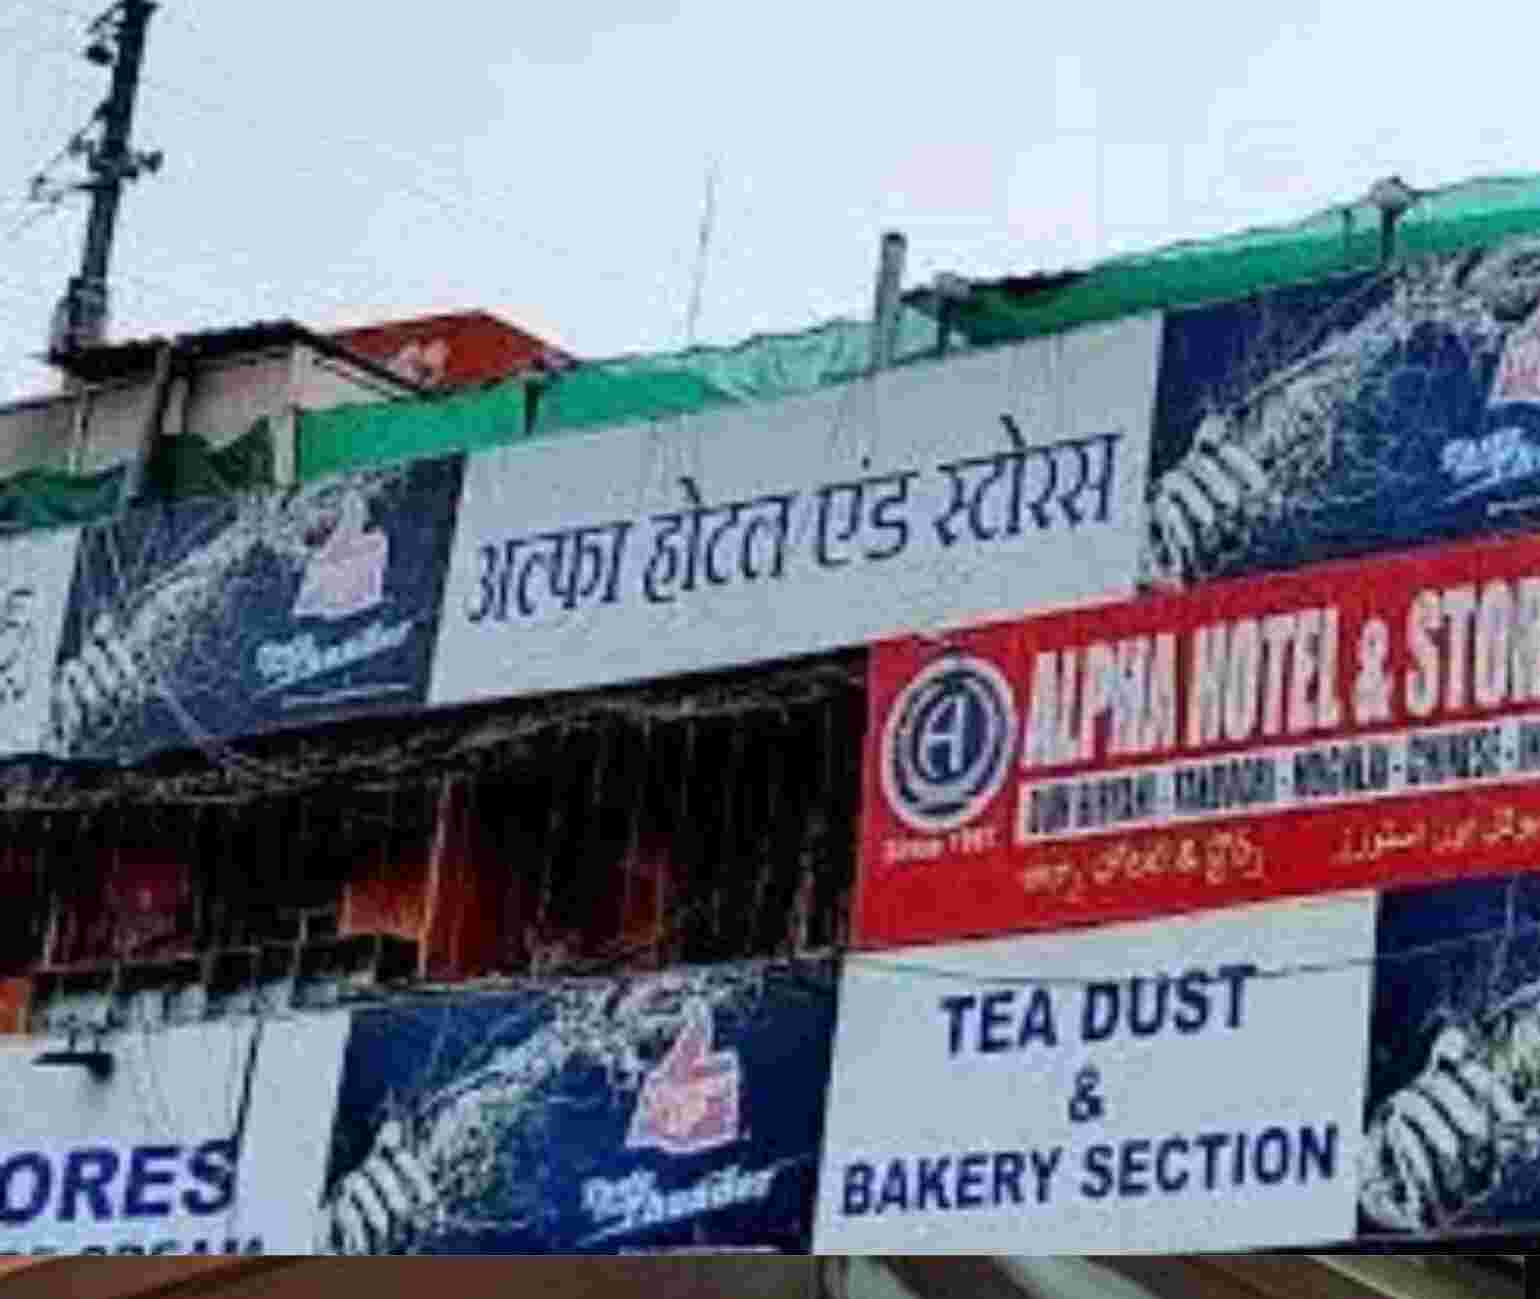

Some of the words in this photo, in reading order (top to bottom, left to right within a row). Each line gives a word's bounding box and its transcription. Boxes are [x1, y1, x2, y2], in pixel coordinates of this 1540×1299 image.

[814, 457, 919, 566] एंड
[1021, 633, 1178, 768] ALPHA
[1187, 606, 1340, 748] HOTEL
[1353, 619, 1393, 724] &
[940, 987, 1058, 1059] TEA
[1080, 964, 1257, 1044] DUST
[1068, 1064, 1105, 1124] &
[840, 1145, 1063, 1218] BAKERY
[1080, 1122, 1339, 1201] SECTION
